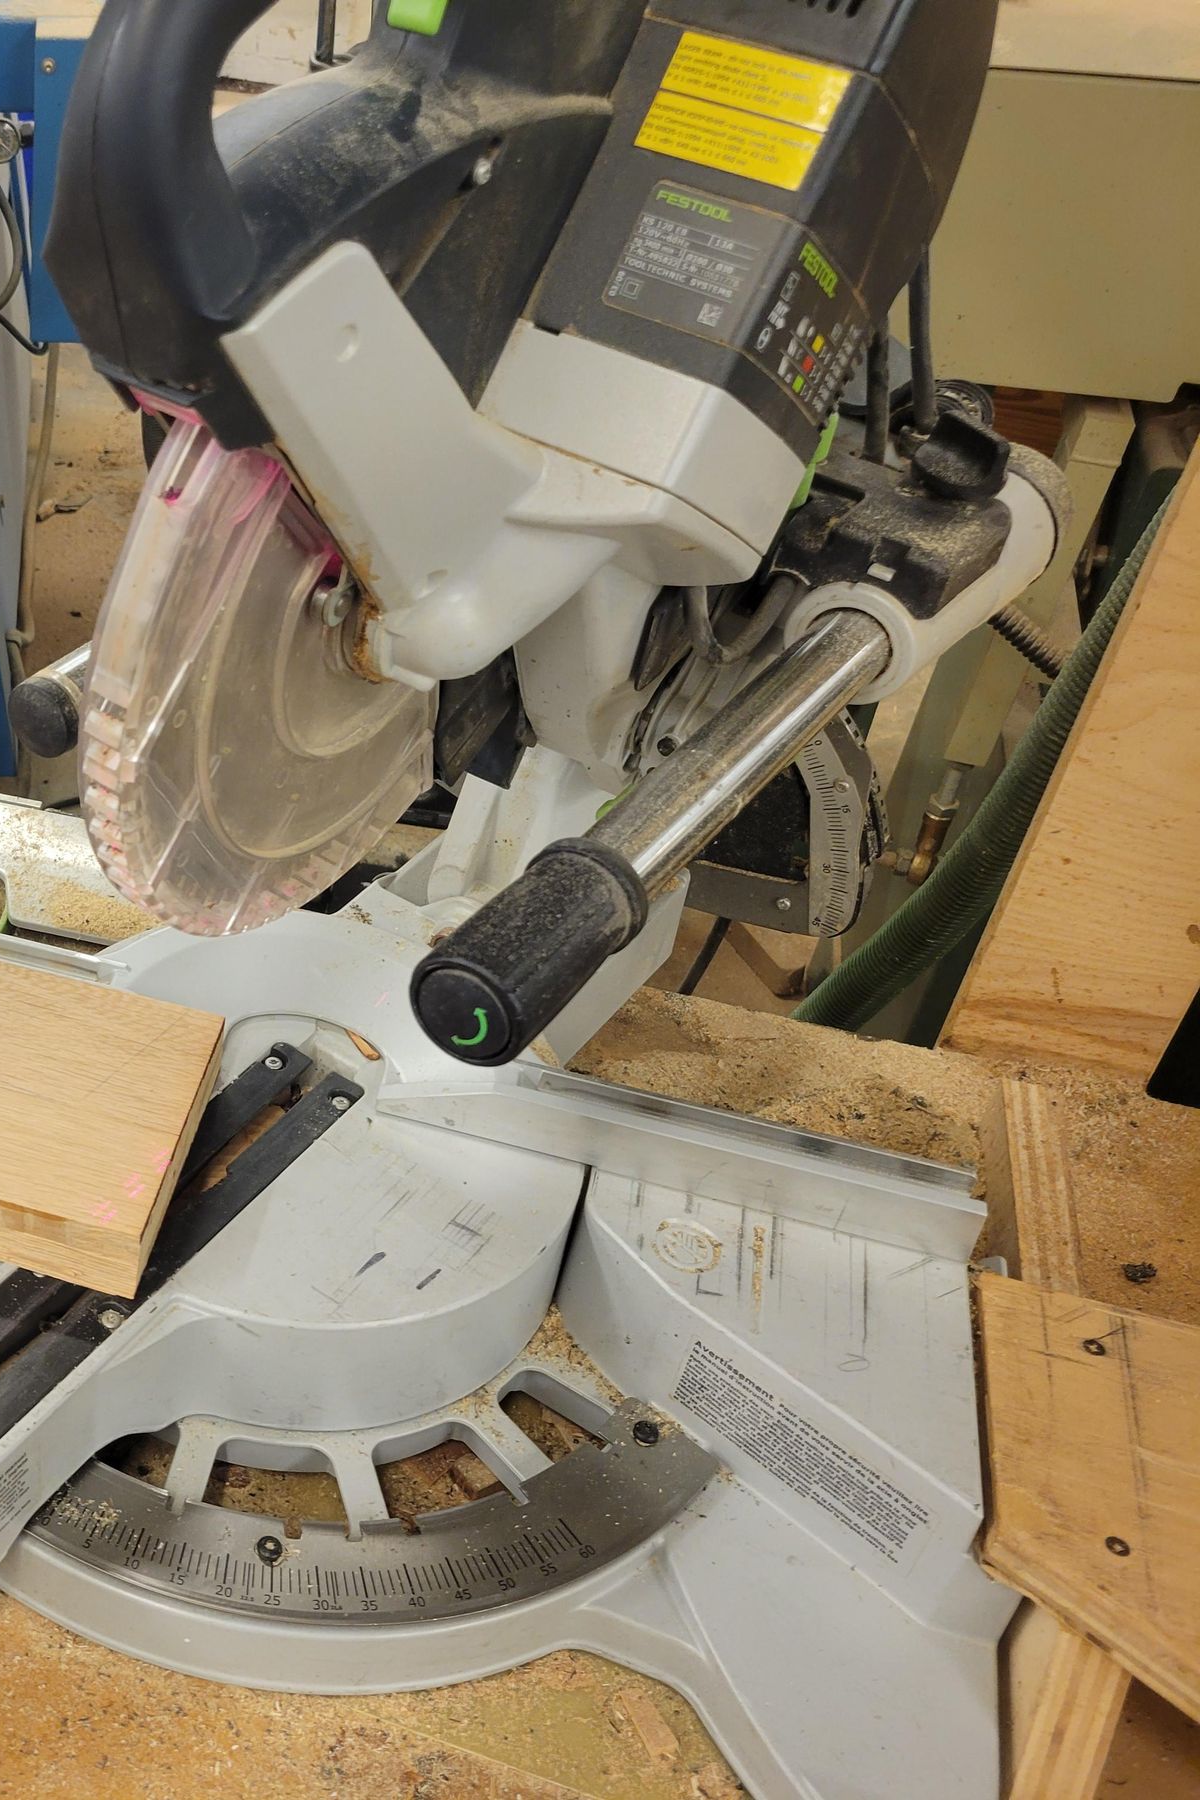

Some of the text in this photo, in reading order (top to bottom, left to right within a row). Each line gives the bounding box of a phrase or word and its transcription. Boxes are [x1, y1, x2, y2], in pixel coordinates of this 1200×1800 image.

[655, 188, 735, 224] FESTOOL
[626, 257, 687, 282] TOOLTECHNIC
[688, 277, 734, 298] SYSTEMS
[798, 240, 841, 300] FESTOOL
[841, 804, 851, 814] 15
[822, 863, 831, 874] 30
[811, 916, 821, 927] 45
[693, 1338, 775, 1403] Avertissement
[777, 1401, 798, 1420] Pour
[796, 1416, 820, 1436] votre
[818, 1433, 848, 1459] propre
[700, 1353, 728, 1377] manuel
[775, 1409, 798, 1429] avant
[797, 1425, 811, 1439] de
[811, 1436, 831, 1453] vous
[899, 1502, 928, 1527] onglet
[82, 1538, 92, 1549] 5
[123, 1556, 141, 1570] 10
[168, 1572, 186, 1586] 15
[215, 1584, 233, 1598] 20
[263, 1593, 281, 1607] 25
[312, 1598, 330, 1611] 30
[361, 1599, 378, 1611] 35
[408, 1596, 426, 1608] 40
[454, 1588, 472, 1602] 45
[498, 1576, 518, 1592] 50
[539, 1562, 559, 1577] 55
[578, 1544, 596, 1560] 60
